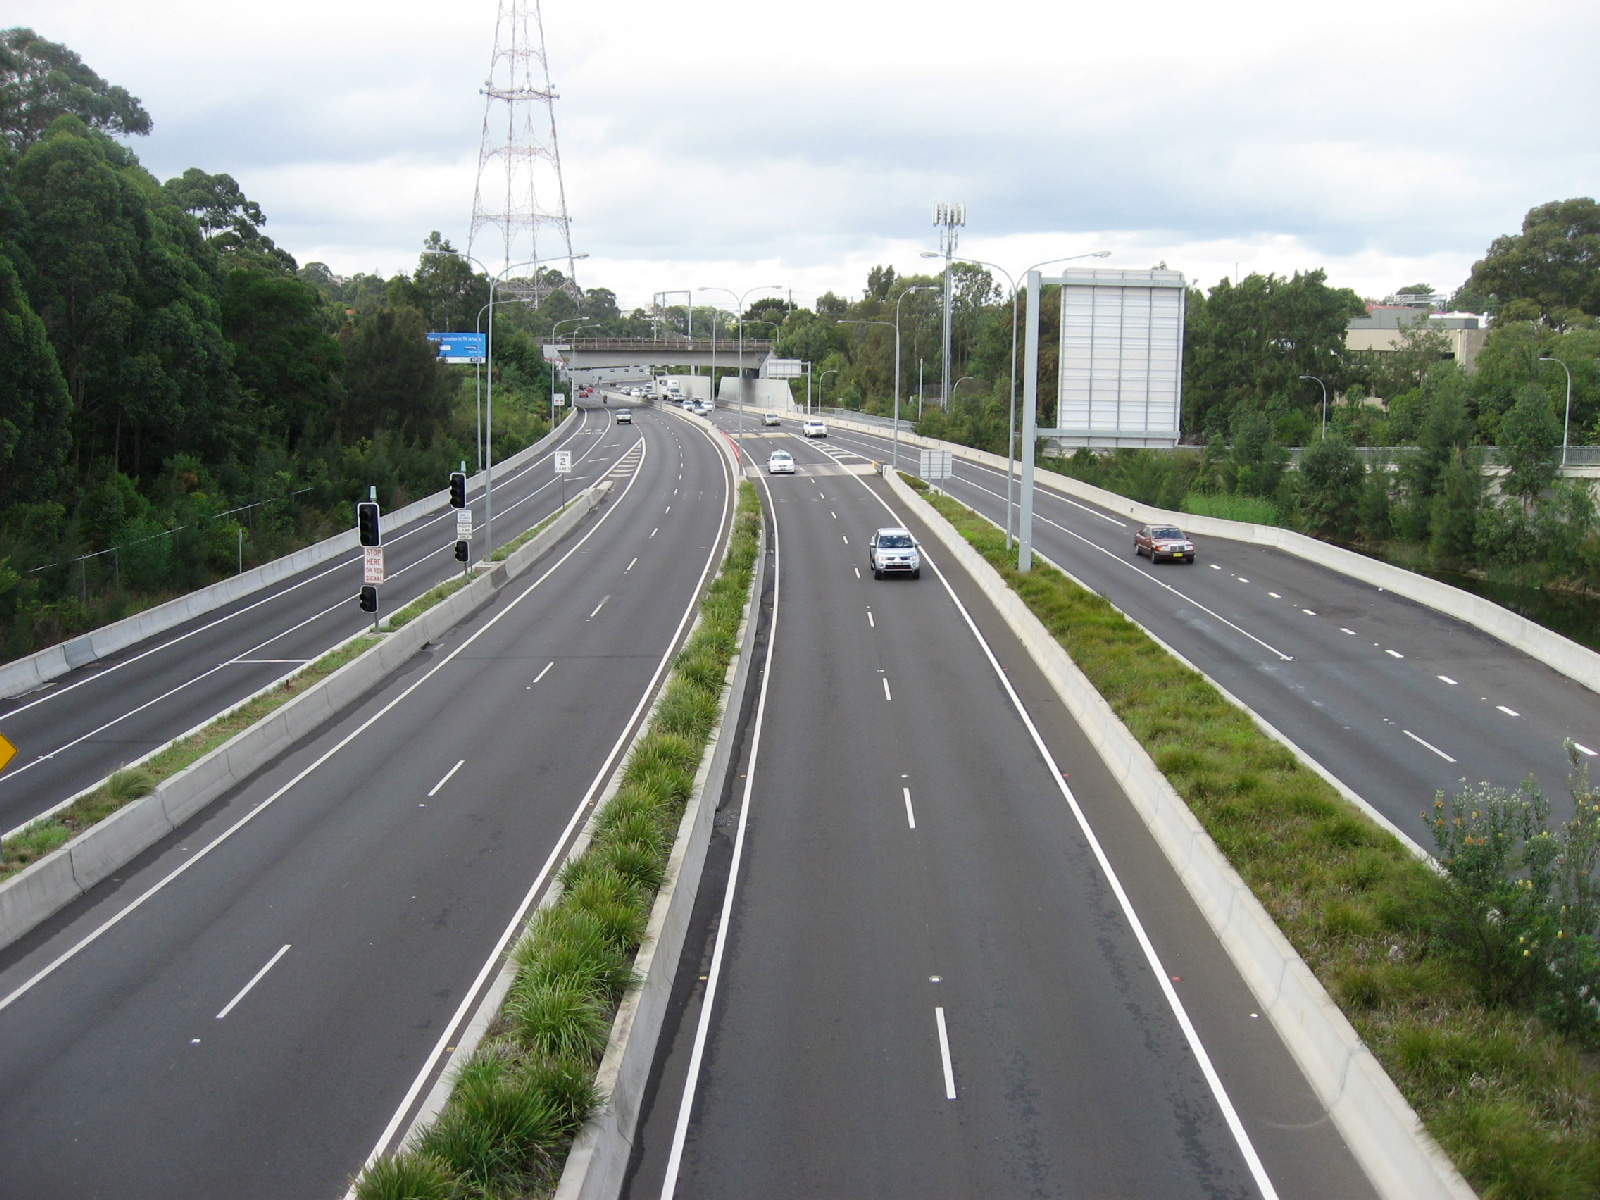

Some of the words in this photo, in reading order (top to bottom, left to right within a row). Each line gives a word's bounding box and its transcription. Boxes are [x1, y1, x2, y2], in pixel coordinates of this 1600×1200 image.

[560, 457, 566, 466] 2
[366, 548, 382, 556] STOP
[373, 566, 383, 574] RED
